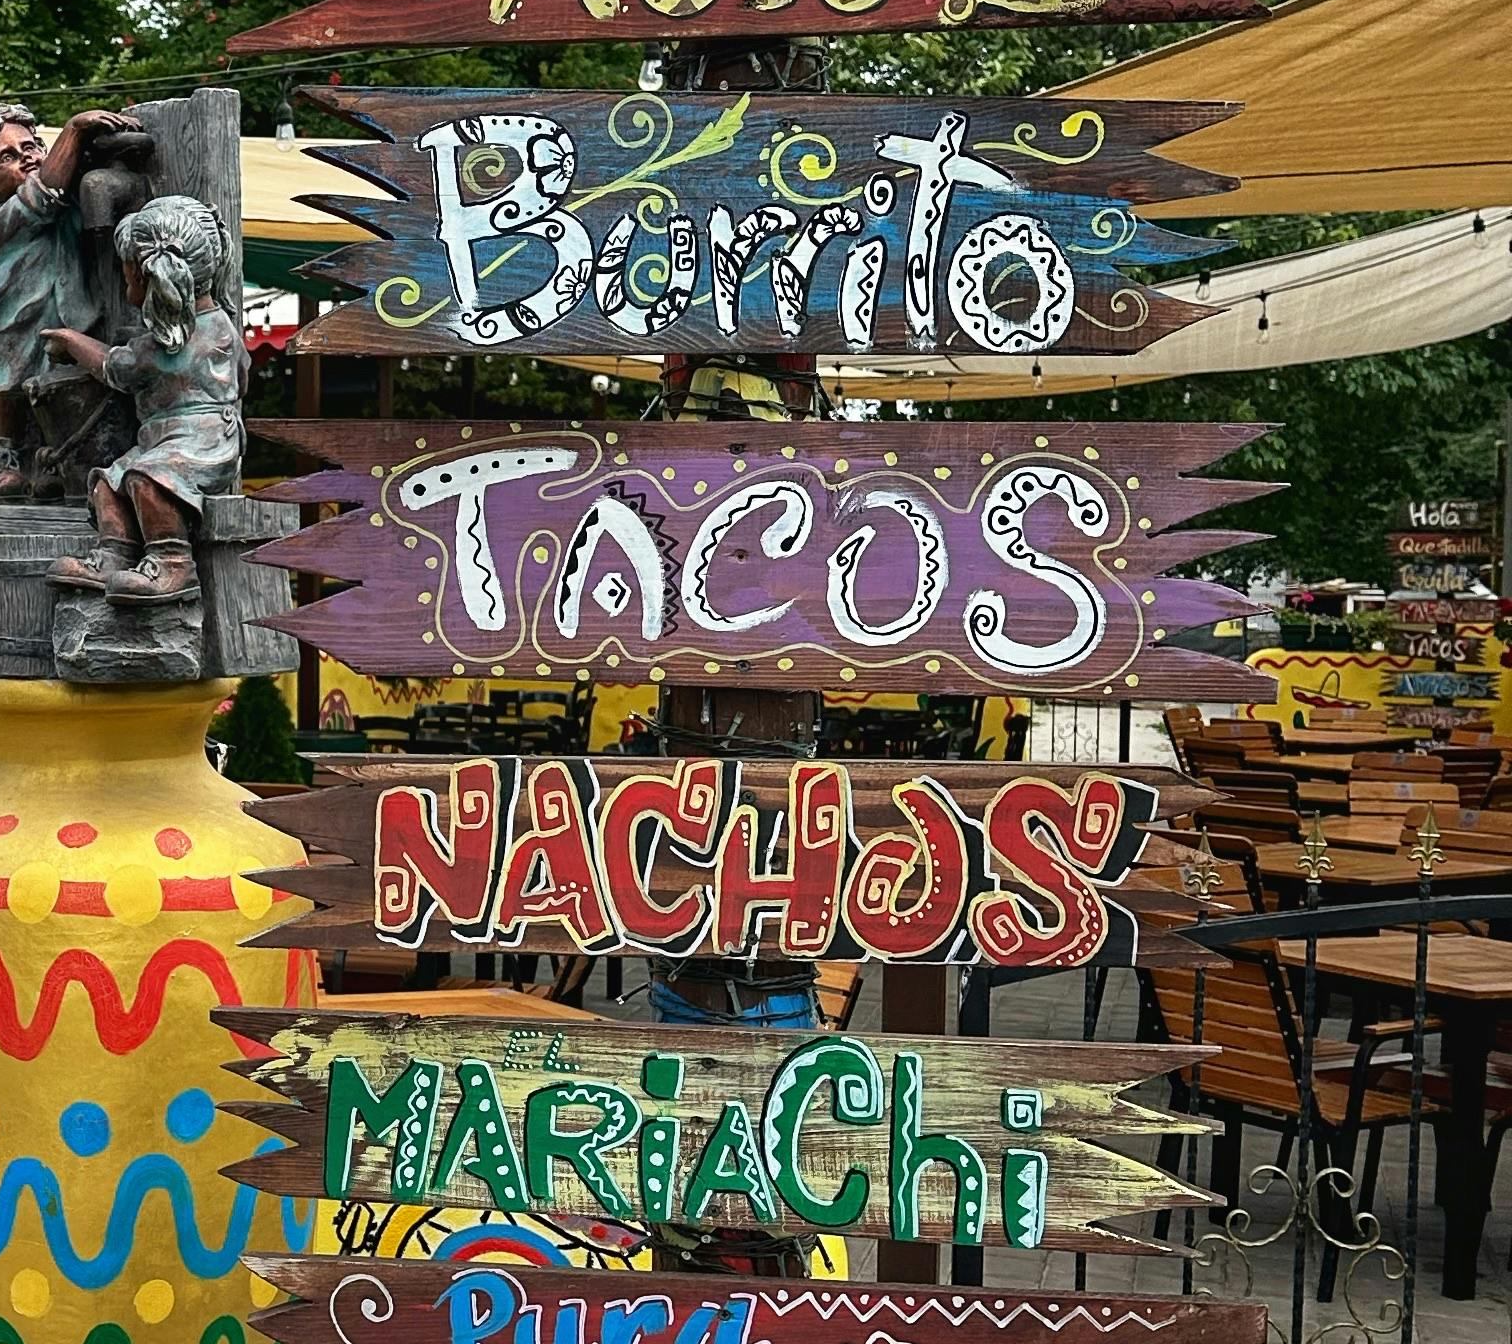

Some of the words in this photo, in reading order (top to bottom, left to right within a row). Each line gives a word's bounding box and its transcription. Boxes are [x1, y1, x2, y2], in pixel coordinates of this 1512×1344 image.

[417, 109, 1075, 354] Burrito
[400, 447, 1108, 674] TACOS
[1409, 502, 1461, 527] Hola
[1402, 632, 1467, 662] TACOS
[373, 757, 1136, 968] NACHOS
[502, 1030, 581, 1073] EL
